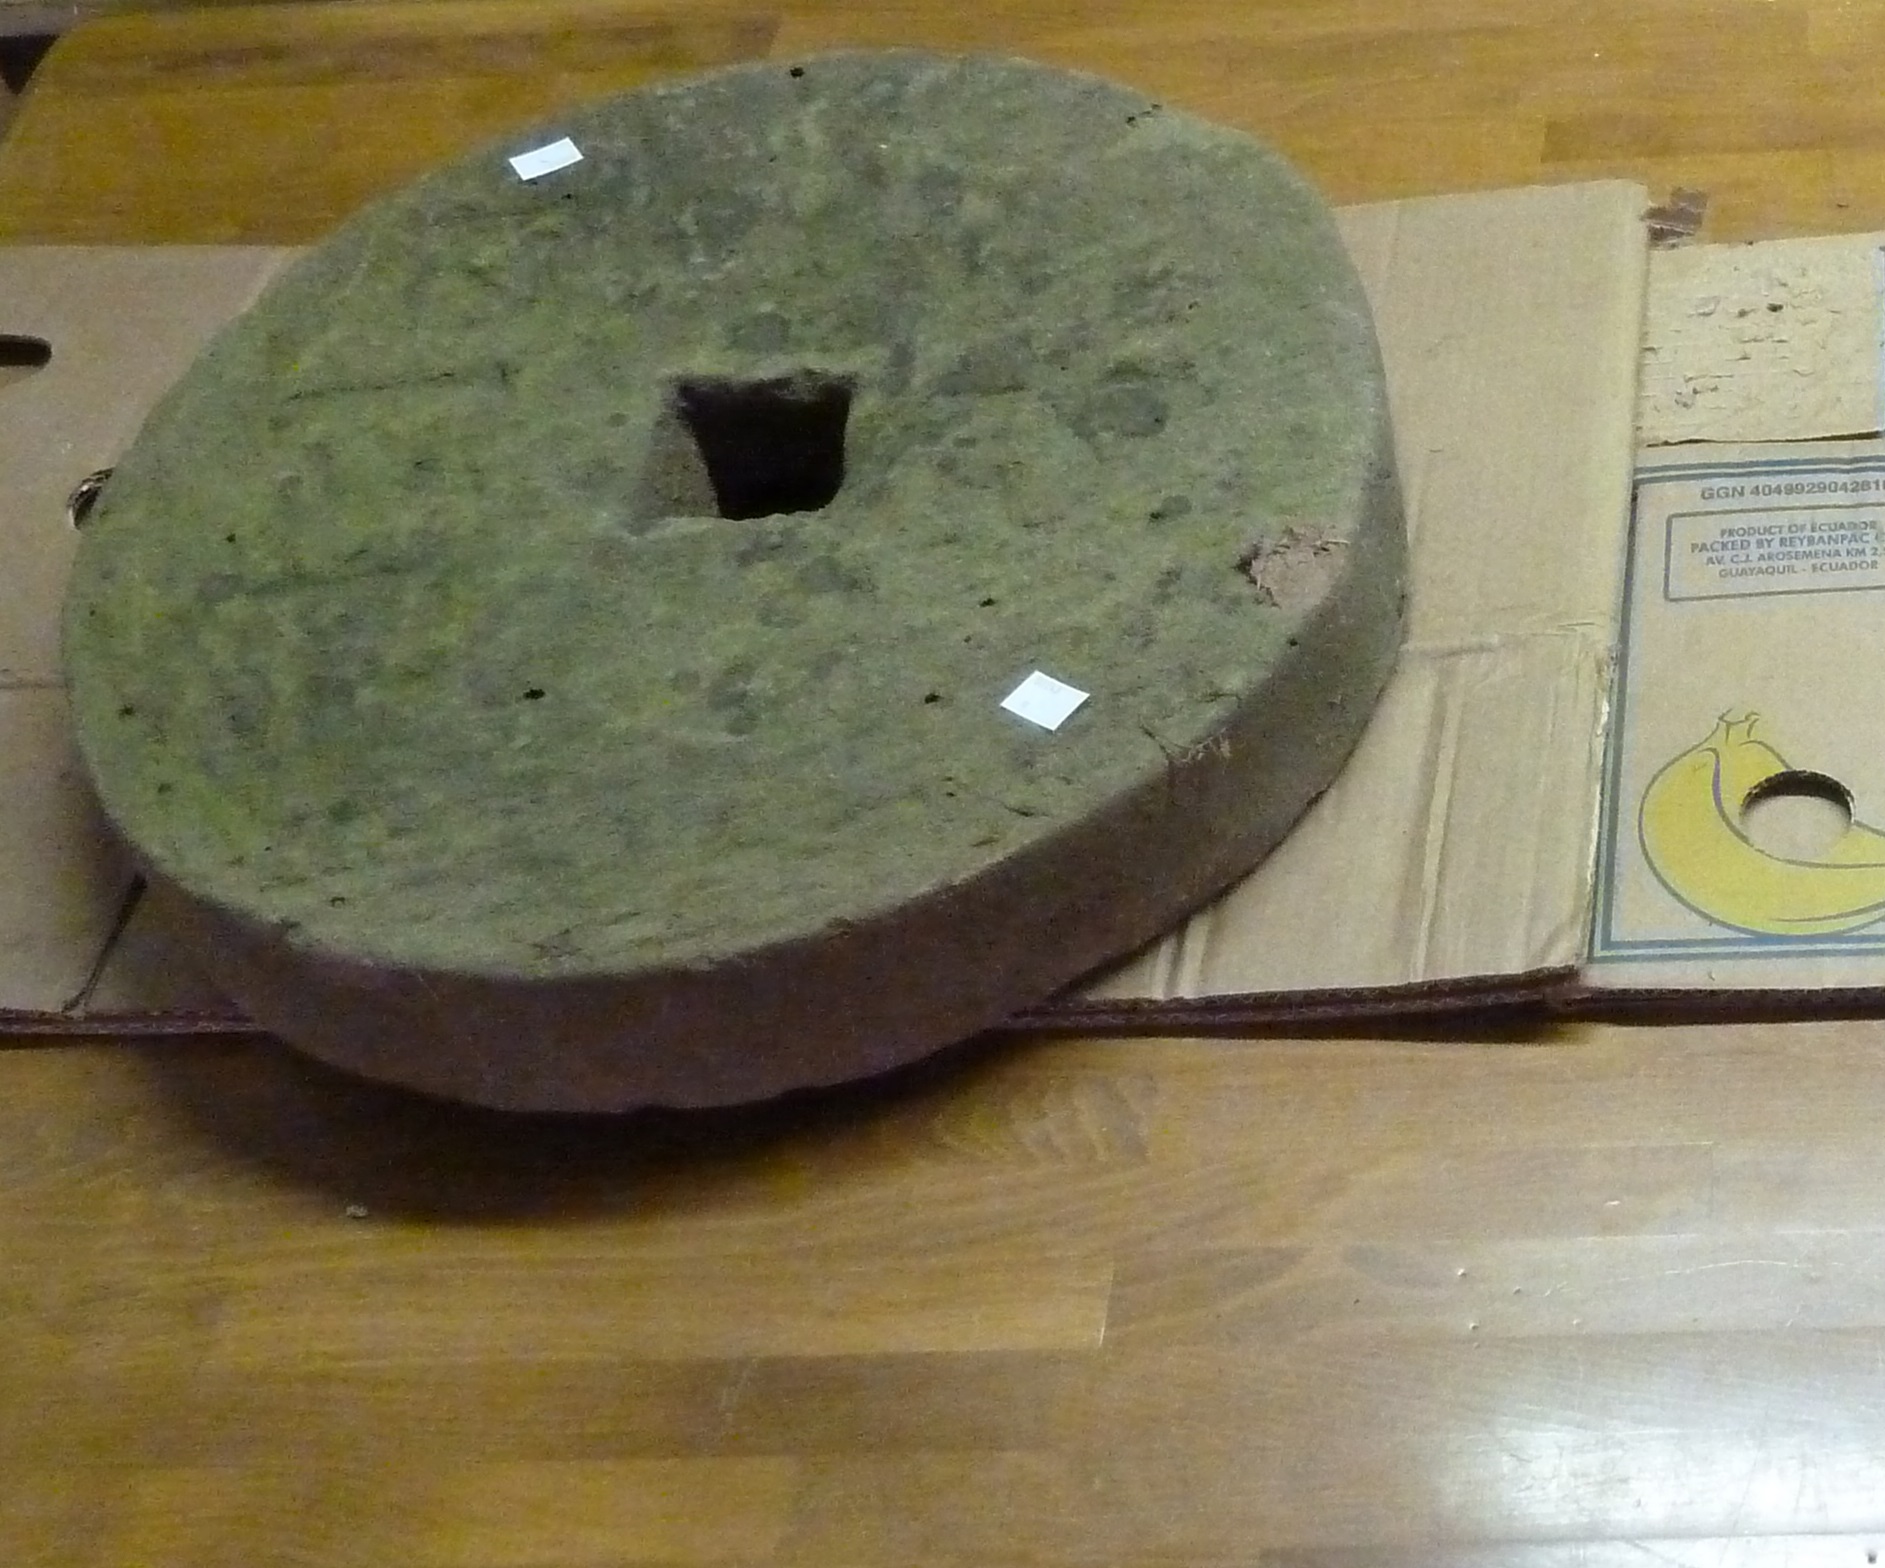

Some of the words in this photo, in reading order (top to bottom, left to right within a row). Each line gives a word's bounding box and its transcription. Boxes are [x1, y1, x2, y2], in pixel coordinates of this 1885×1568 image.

[1700, 485, 1745, 500] GGN
[1720, 525, 1784, 539] PRODUCT
[1787, 523, 1806, 535] OF
[1811, 520, 1878, 534] ECUADOR
[1690, 539, 1751, 553] PACKED
[1756, 537, 1775, 550] BY
[1778, 533, 1870, 549] REYBANPAC
[1756, 548, 1842, 563] AROSEMENA
[1846, 547, 1867, 558] KM
[1718, 563, 1797, 579] GUAYAQUIL
[1811, 560, 1879, 574] ECUADOR
